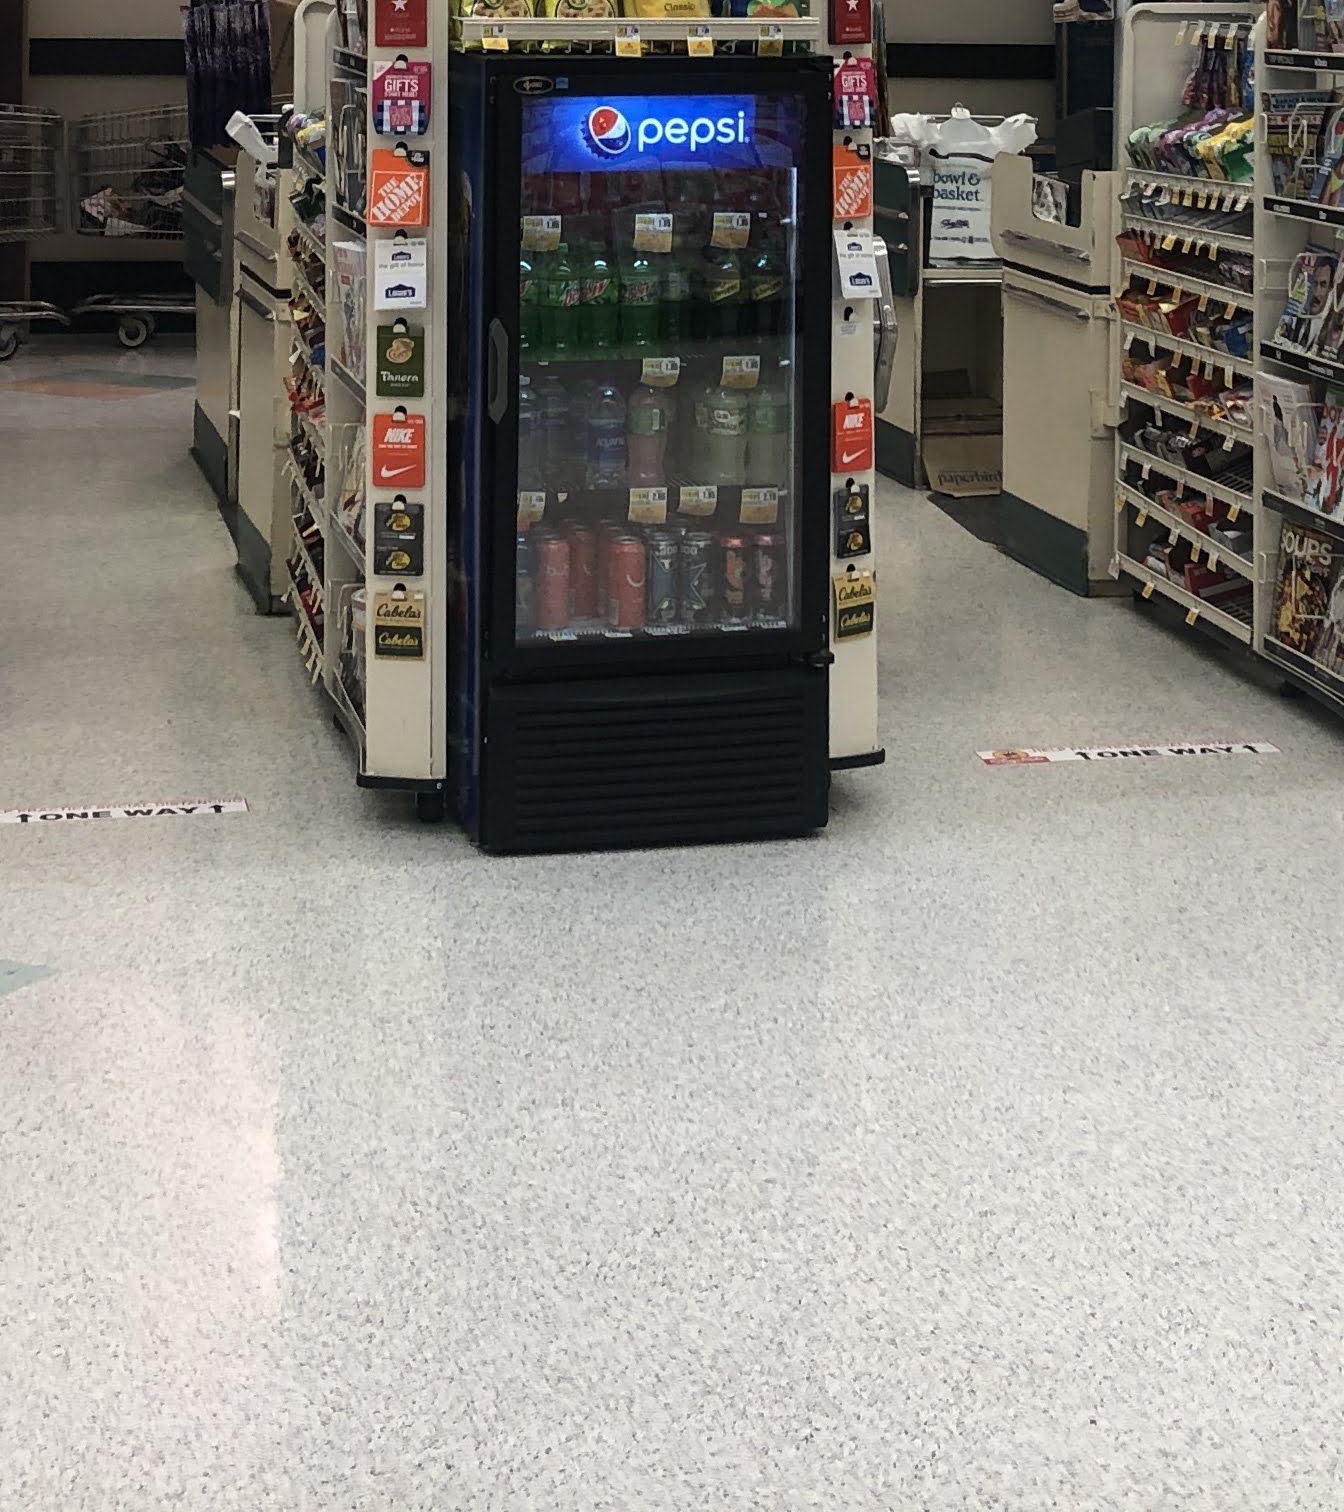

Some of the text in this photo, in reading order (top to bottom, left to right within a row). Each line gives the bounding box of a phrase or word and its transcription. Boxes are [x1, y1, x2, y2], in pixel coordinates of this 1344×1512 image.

[663, 1, 696, 12] Classic
[384, 79, 419, 92] GIFTS
[841, 75, 867, 87] GIFTS
[638, 110, 746, 153] pepsi
[378, 175, 400, 197] THE
[933, 171, 981, 186] bowl &
[371, 172, 423, 222] HOME
[380, 370, 419, 383] Panera
[842, 413, 865, 430] NIKE
[383, 427, 415, 444] NIKE
[1096, 746, 1234, 758] ONE WAY
[38, 809, 113, 822] ONE
[123, 806, 198, 818] WAY
